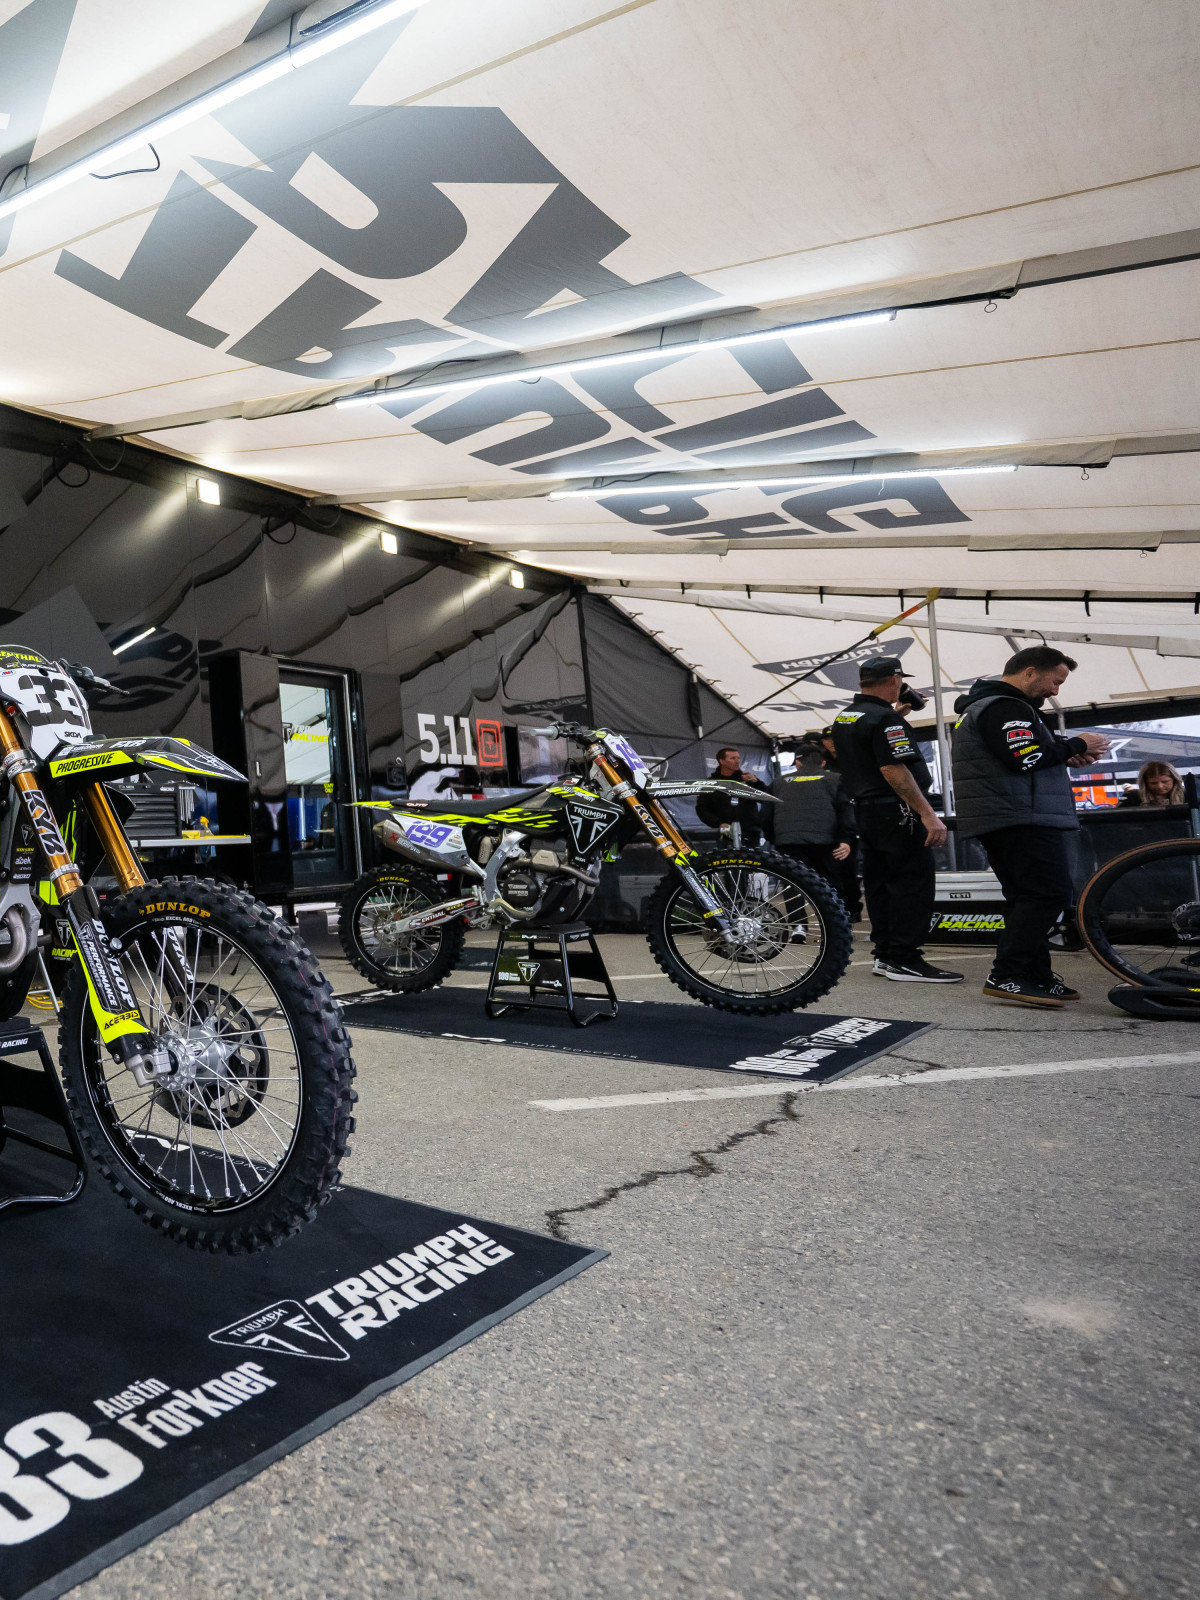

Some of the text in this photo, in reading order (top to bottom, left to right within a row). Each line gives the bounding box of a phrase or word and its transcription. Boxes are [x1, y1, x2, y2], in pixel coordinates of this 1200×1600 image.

[1001, 720, 1033, 730] FXR
[108, 739, 147, 749] FXR
[292, 733, 329, 742] RACING
[417, 713, 478, 766] 5.11
[56, 753, 114, 774] PROGRESSIVE
[654, 786, 702, 797] PROGRESSIVE
[574, 806, 607, 820] TRIUMPH
[713, 859, 762, 867] DUNLOP
[145, 901, 212, 919] DUNLOP
[938, 921, 1006, 929] RACING
[86, 940, 119, 1007] PERFORMANCE
[103, 1011, 141, 1031] ACERBIS
[1, 1037, 29, 1049] RACING
[304, 1222, 491, 1317] TRIUMPH
[338, 1239, 516, 1340] RACING
[228, 1307, 288, 1340] TRIUMPH
[92, 1376, 171, 1421] Austin
[117, 1360, 278, 1449] Forkner
